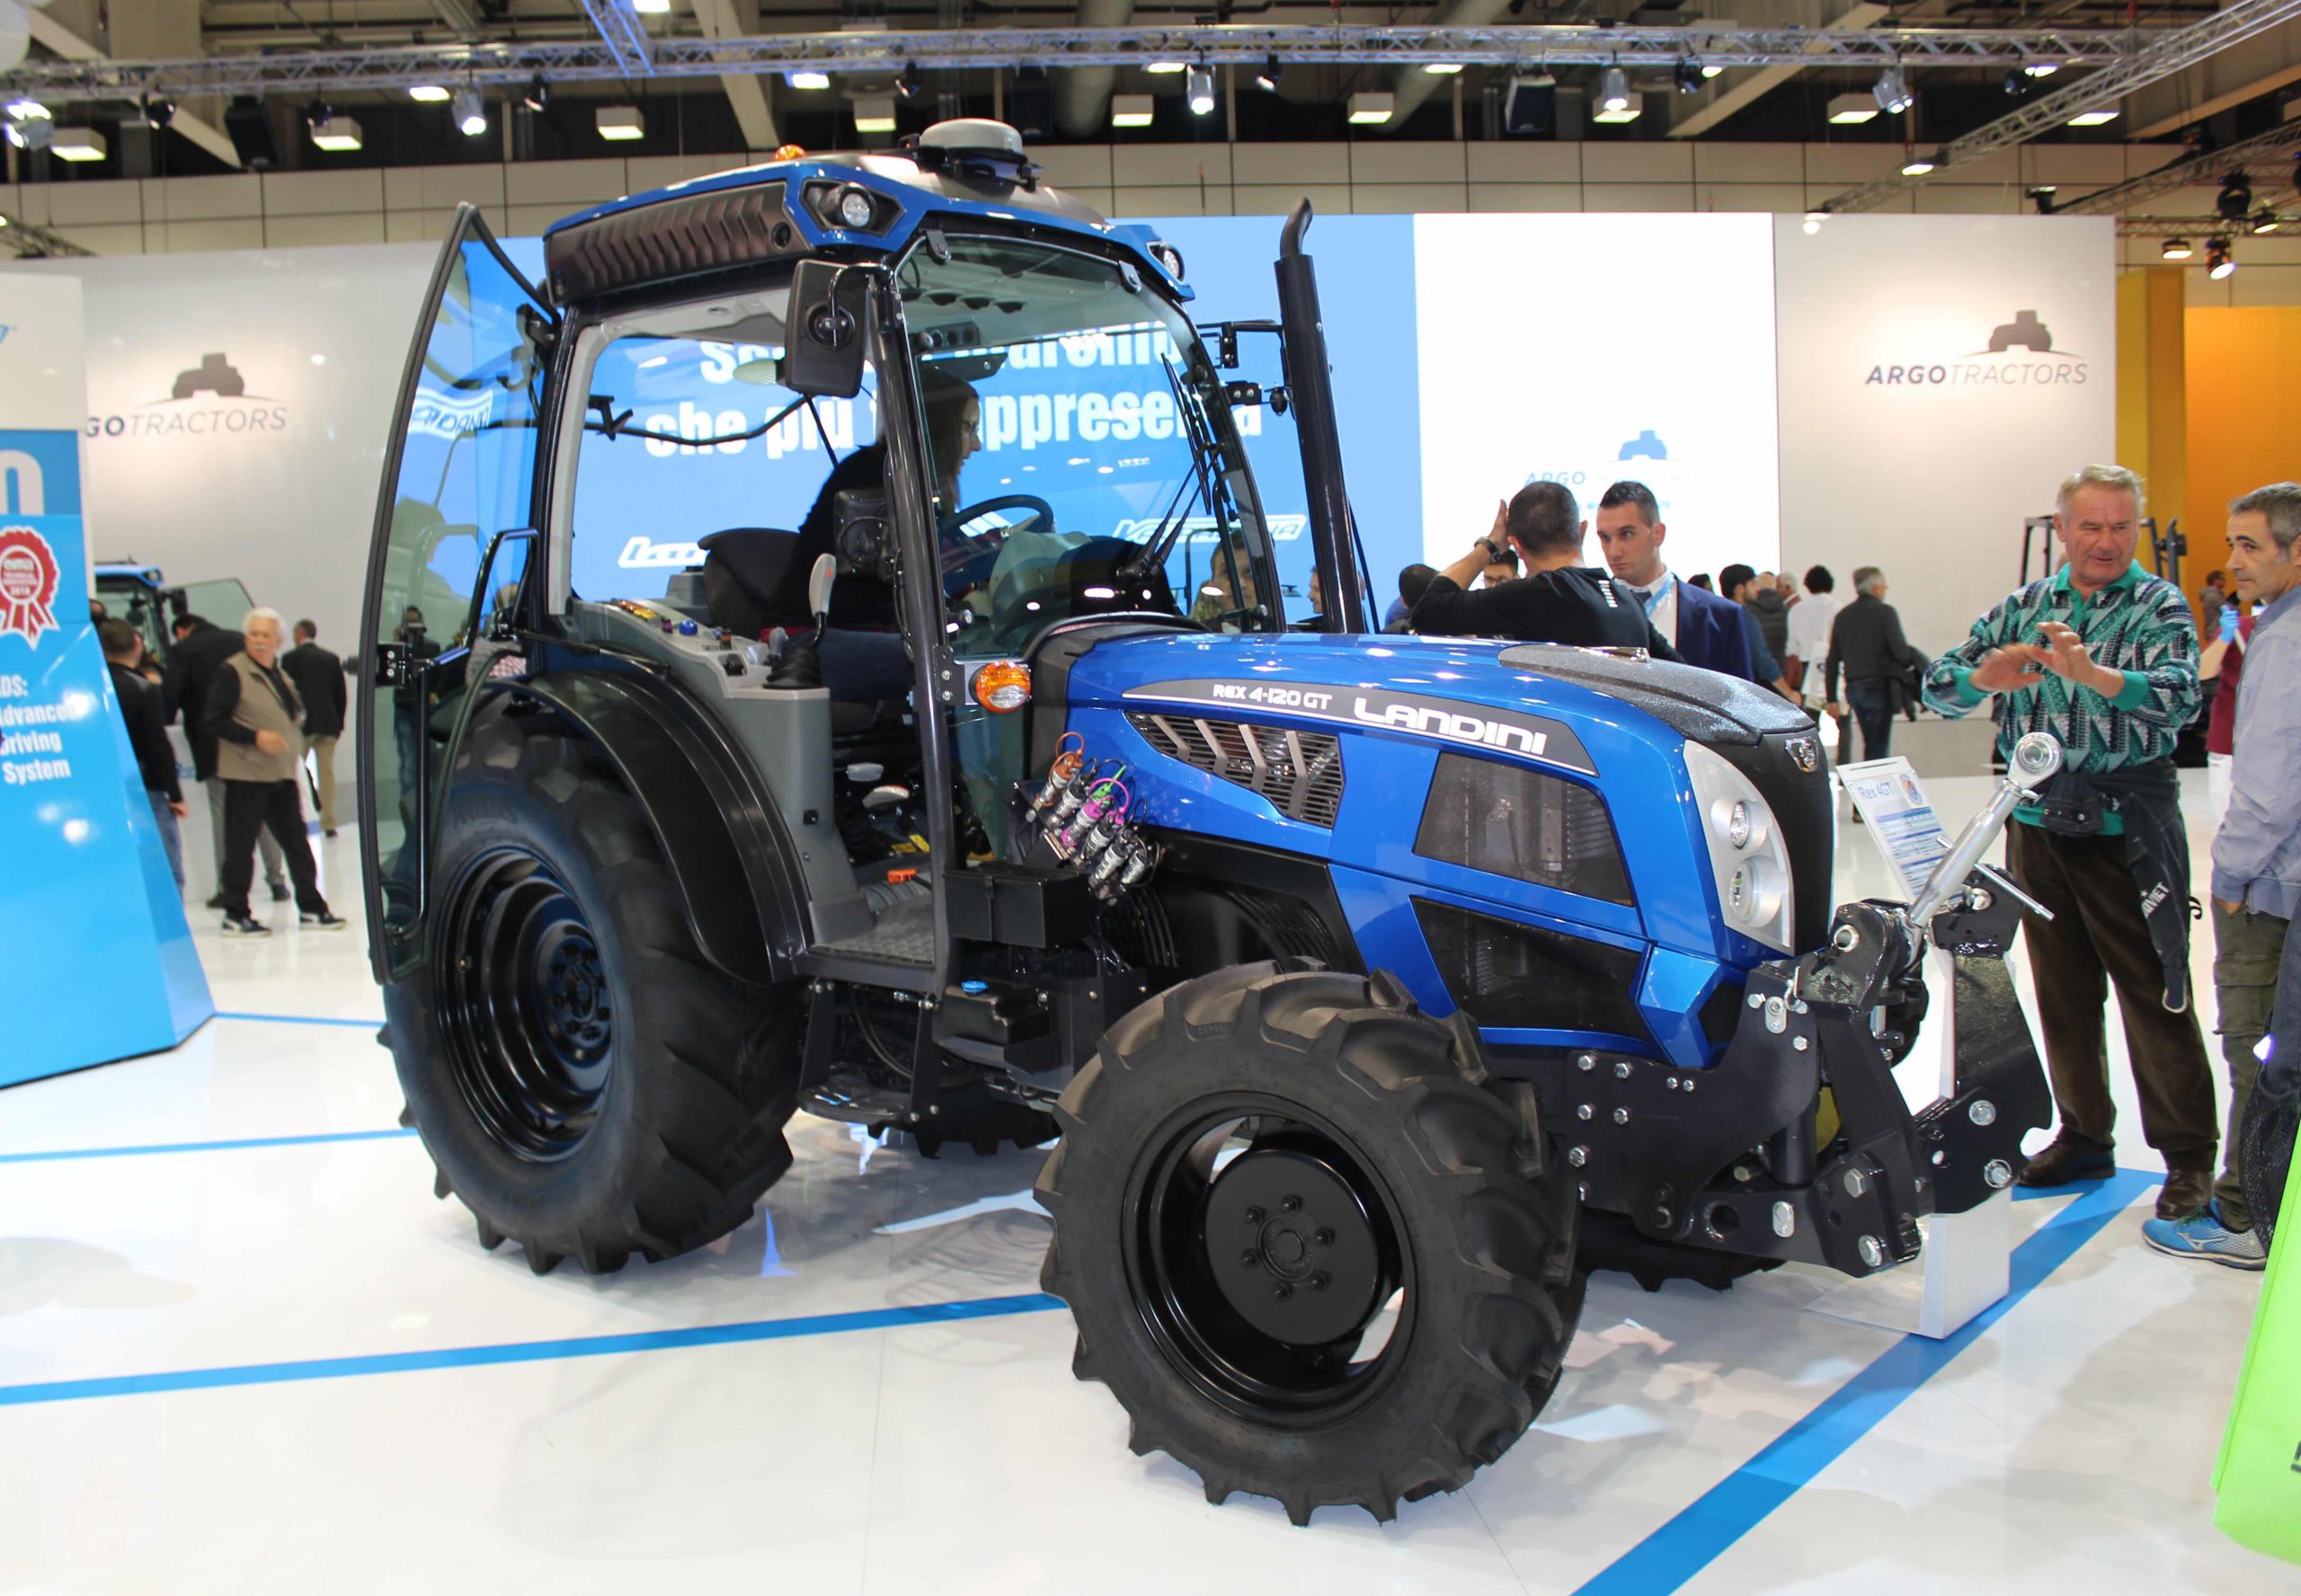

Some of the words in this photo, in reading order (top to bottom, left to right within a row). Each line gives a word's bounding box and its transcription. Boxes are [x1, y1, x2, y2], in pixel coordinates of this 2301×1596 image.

[644, 401, 748, 456] che
[0, 674, 28, 698] DS:
[1213, 684, 1247, 700] REX
[1303, 691, 1333, 710] GT
[1354, 697, 1548, 756] LANDINI
[2, 759, 72, 785] System
[1858, 785, 1875, 801] Rex
